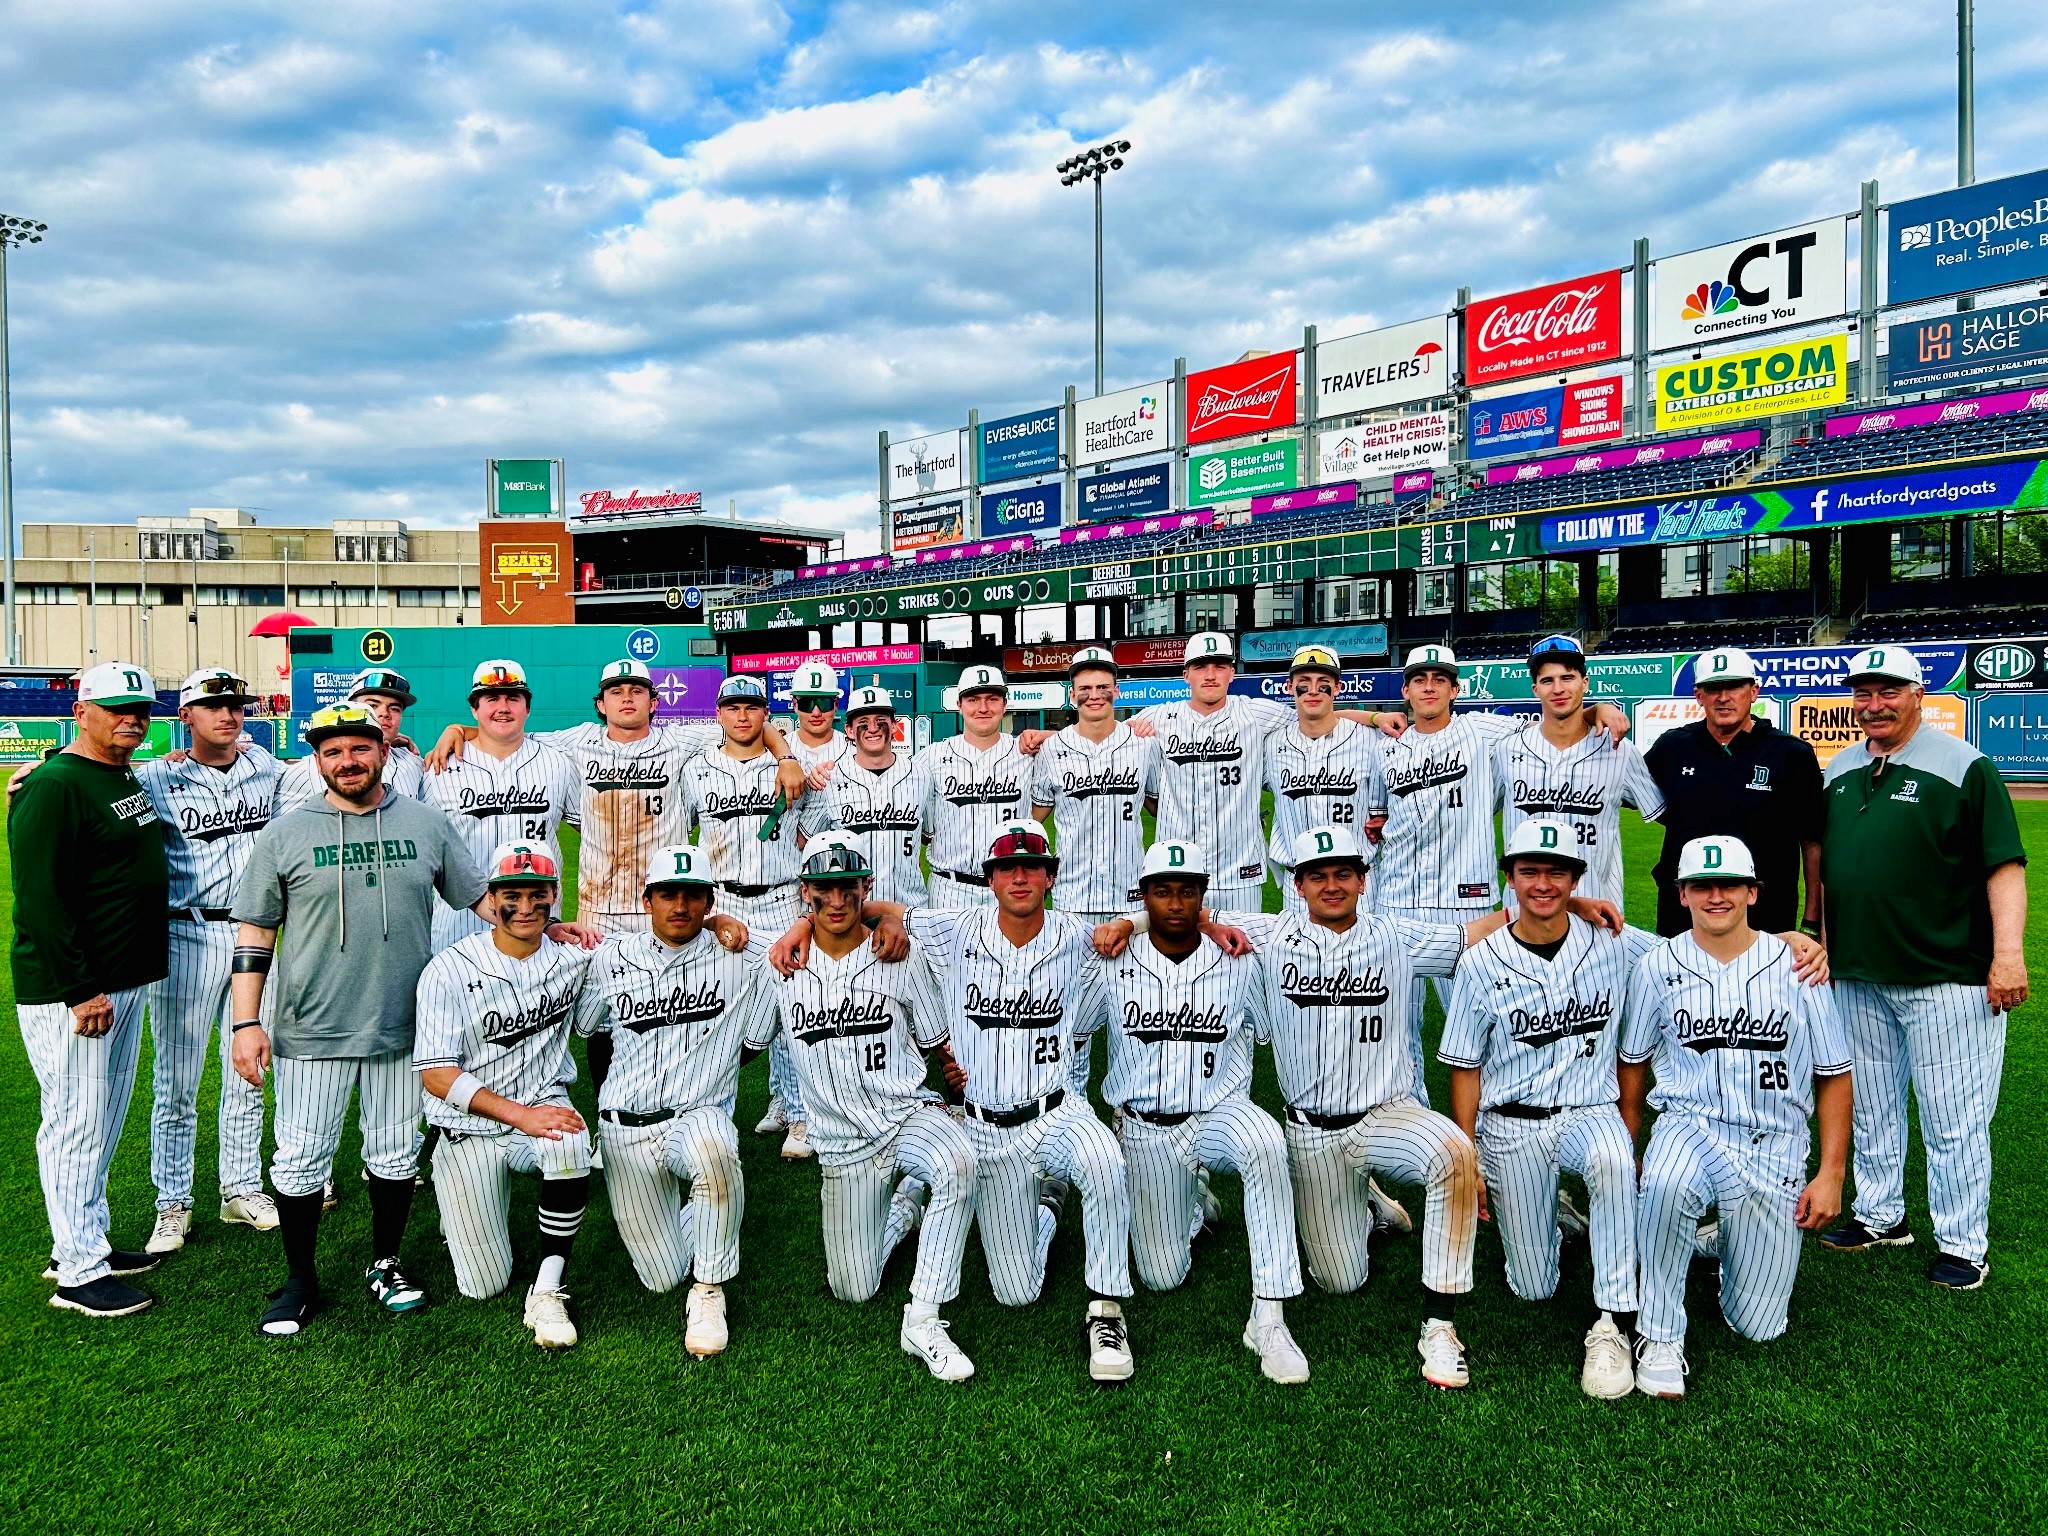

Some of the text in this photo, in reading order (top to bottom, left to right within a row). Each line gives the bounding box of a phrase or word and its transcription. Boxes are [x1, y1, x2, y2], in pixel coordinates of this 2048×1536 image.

[1936, 237, 2033, 267] Real. Simple.
[1728, 231, 1816, 307] CT
[1478, 283, 1606, 352] Coca-Cola
[1694, 307, 1796, 335] Connecting You
[1961, 331, 2020, 356] SAGE
[1478, 341, 1606, 375] Locally Made in CT since 1912
[1321, 358, 1420, 395] TRAVELERS
[1665, 344, 1836, 399] CUSTOM
[1893, 372, 1941, 388] PROTECTING
[1943, 369, 1960, 379] OUR
[1996, 361, 2022, 373] LEGAL
[1197, 388, 1281, 419] Budweiser
[1573, 384, 1615, 401] WINDOWS
[1667, 375, 1836, 412] EXTERIOR LANDSCAPE
[1579, 398, 1607, 412] SIDING
[1678, 391, 1831, 423] Division of Enterprises, LLC
[1938, 401, 1980, 422] Jordan's
[1085, 411, 1136, 436] Hartford
[1366, 414, 1444, 437] CHILD MENTAL
[1498, 406, 1547, 433] AWS
[1579, 410, 1607, 424] DOORS
[1856, 413, 1896, 433] Jordan's
[986, 416, 1055, 445] EVERSOURCE
[1085, 429, 1153, 453] HealthCare
[1363, 426, 1446, 449] HEALTH CRISIS?
[1561, 420, 1620, 439] SHOWER/BATH
[1363, 440, 1446, 463] Get Help NOW.
[1629, 447, 1665, 466] Jordan's
[1698, 437, 1733, 455] Jordan's
[895, 453, 955, 479] The Hartford
[1231, 449, 1285, 469] Better Built
[1231, 461, 1285, 479] Basements
[1324, 458, 1359, 474] Village
[503, 481, 546, 491] M&T Bank
[1100, 475, 1161, 494] Global Atlantic
[1838, 480, 1997, 508] /hartfordyardgoats
[579, 489, 702, 516] Budweiser
[1445, 524, 1453, 541] 5
[1489, 516, 1516, 531] INN
[1557, 499, 1747, 543] FOLLOW THE Yard Goats
[1421, 527, 1431, 565] RUNS
[1444, 545, 1453, 562] 4
[1505, 533, 1515, 555] 7
[498, 555, 552, 567] BEAR'S
[1092, 545, 1283, 581] DEERFIELD 0 0 0 0 5 0
[1085, 564, 1283, 599] WESTMINSTER 0 0 0
[668, 592, 698, 604] 21 42
[819, 585, 1014, 618] BALLS STRIKES OUTS
[713, 608, 747, 632] 5:56 PM
[368, 638, 386, 656] 21
[632, 637, 654, 654] 42
[1145, 651, 1156, 659] OF
[1204, 637, 1218, 653] D
[1426, 648, 1439, 663] D
[765, 647, 914, 667] AMERICA'S 5G NETWORK Mobile
[1712, 654, 1728, 672] D
[1866, 650, 1886, 670] D
[122, 670, 143, 692] D
[619, 662, 632, 677] D
[810, 671, 822, 689] D
[976, 669, 990, 684] D
[1013, 690, 1043, 701] Home
[2002, 681, 2034, 689] PRODUCTS
[863, 689, 876, 705] D
[1644, 704, 1681, 719] ALL
[27, 738, 57, 747] TRAIN
[1166, 732, 1242, 761] Deerfield
[1387, 750, 1467, 791] Deerfield
[1992, 755, 2006, 763] 50
[586, 760, 668, 789] Deerfield
[1063, 766, 1139, 795] Deerfield
[1219, 765, 1241, 787] 33
[1280, 766, 1357, 795] Deerfield
[460, 785, 548, 814] Deerfield
[944, 775, 1021, 803] Deerfield
[1448, 786, 1463, 808] 11
[1513, 779, 1605, 812] Deerfield
[1890, 793, 1920, 803] BASEBALL
[181, 796, 271, 834] Deerfield
[645, 795, 663, 815] 13
[841, 802, 918, 830] Deerfield
[1122, 801, 1133, 821] 2
[1332, 802, 1354, 824] 22
[525, 819, 547, 841] 24
[1540, 826, 1558, 848] D
[1574, 821, 1597, 846] 32
[313, 839, 418, 868] DEERFIELD
[904, 836, 913, 856] 5
[1315, 831, 1334, 854] D
[674, 852, 692, 874] D
[1168, 846, 1185, 867] D
[1703, 845, 1722, 869] D
[1281, 962, 1389, 1006] Deerfield
[483, 977, 577, 1039] Deerfield
[618, 979, 725, 1024] Deerfield
[964, 983, 1064, 1028] Deerfield
[1510, 988, 1613, 1036] Deerfield
[792, 997, 893, 1037] Deerfield
[1123, 1000, 1228, 1041] Deerfield
[1674, 1006, 1789, 1048] Deerfield
[1359, 1015, 1383, 1044] 10
[864, 1040, 887, 1072] 12
[1034, 1034, 1061, 1066] 23
[1203, 1051, 1215, 1079] 9
[1758, 1059, 1789, 1091] 26
